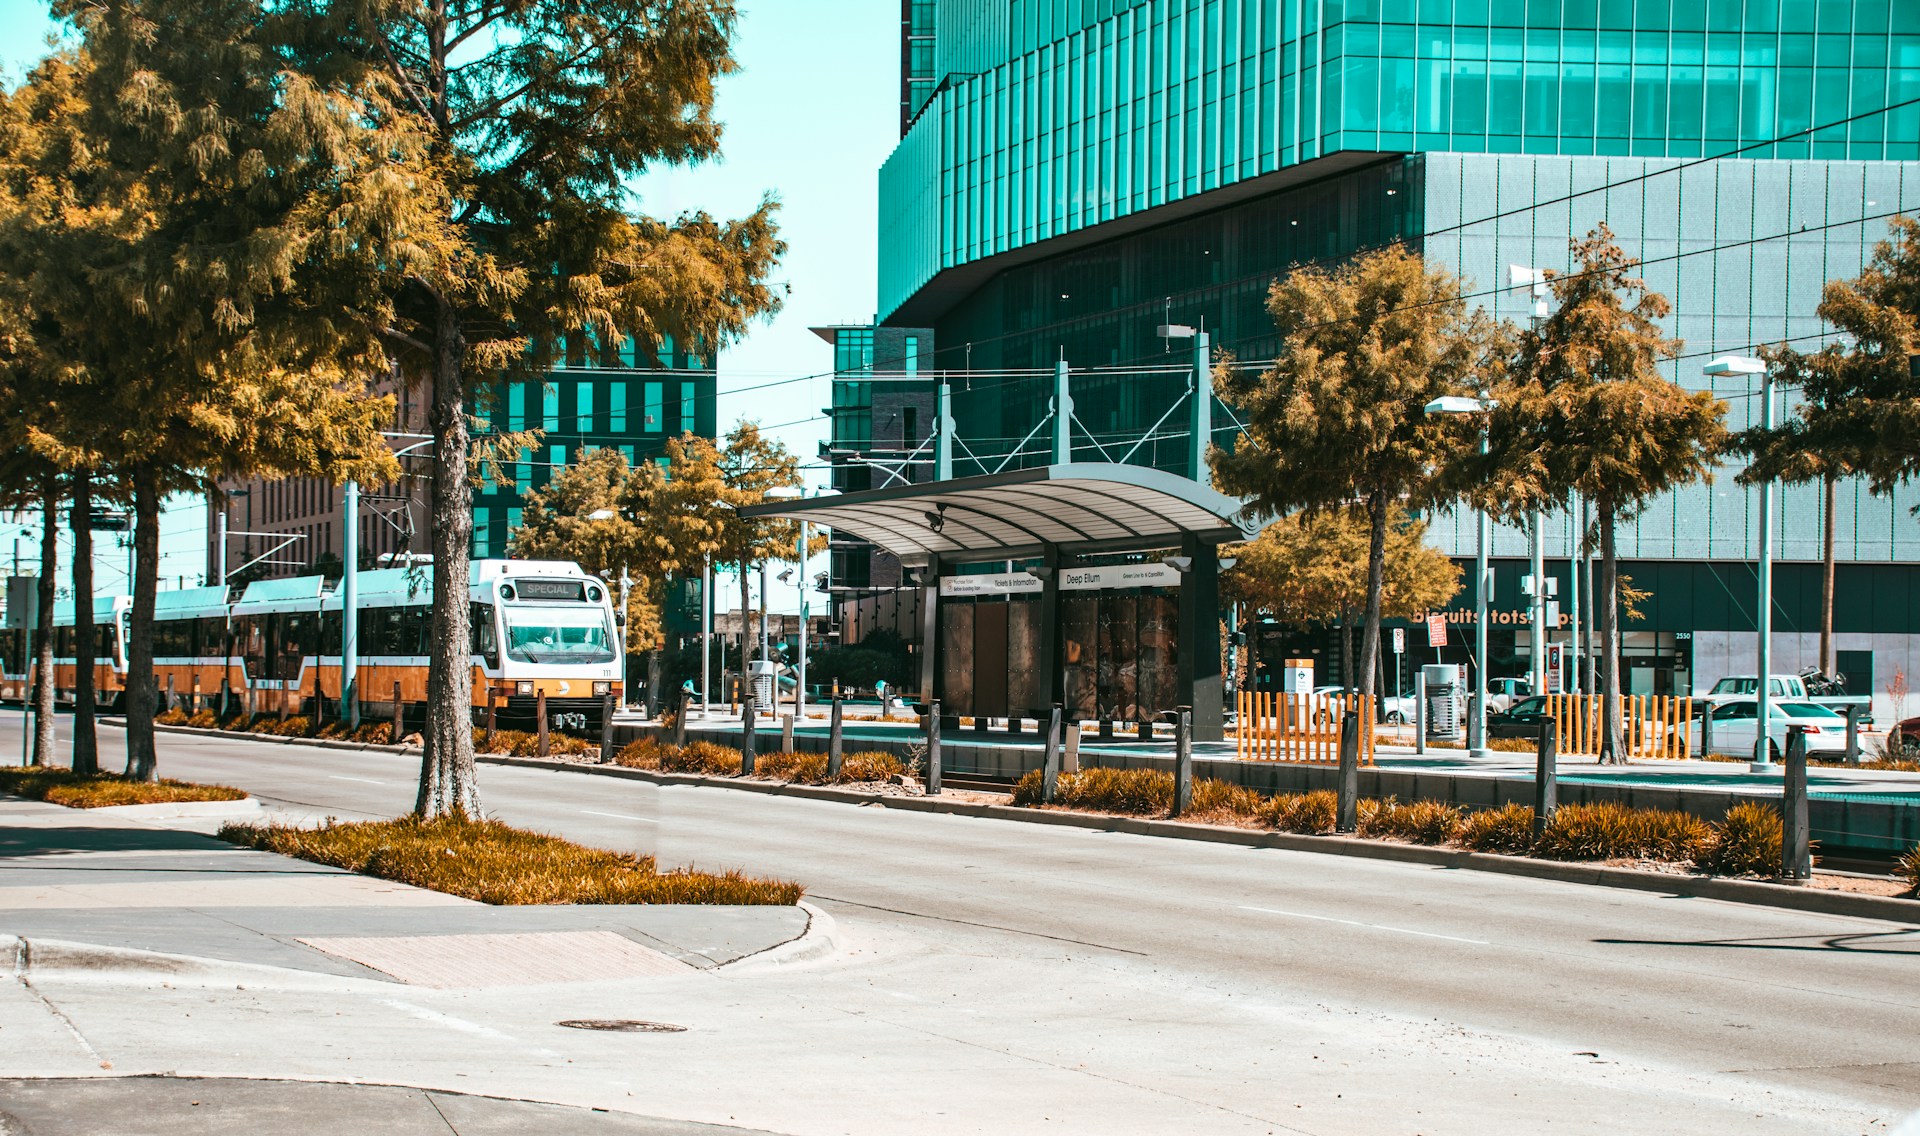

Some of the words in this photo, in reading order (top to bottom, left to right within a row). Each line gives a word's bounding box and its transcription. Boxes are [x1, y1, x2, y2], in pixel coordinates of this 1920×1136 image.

[994, 579, 1008, 587] Tickets
[1008, 579, 1012, 587] &
[1013, 578, 1036, 587] Information
[1066, 574, 1083, 586] Deep
[1084, 573, 1101, 583] Ellum
[527, 584, 569, 594] SPECIAL
[1675, 632, 1691, 640] 2550
[603, 669, 612, 677] 111
